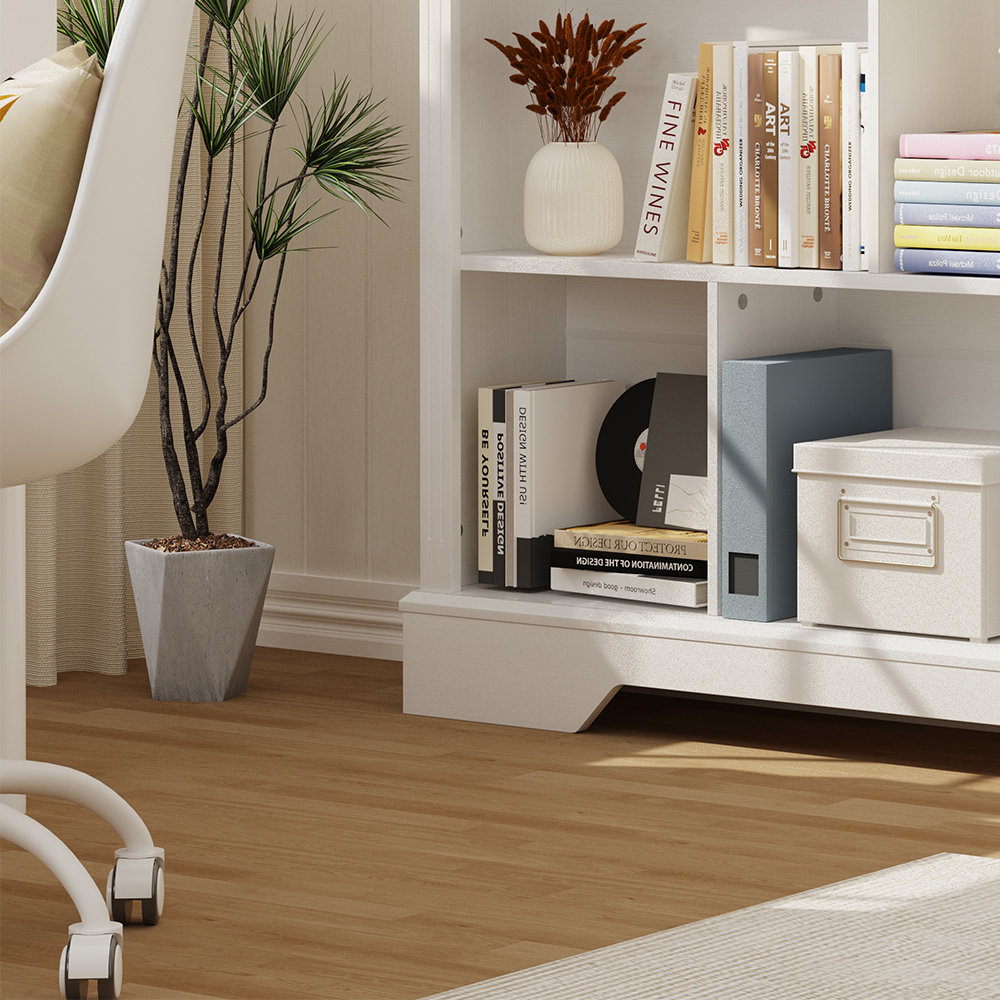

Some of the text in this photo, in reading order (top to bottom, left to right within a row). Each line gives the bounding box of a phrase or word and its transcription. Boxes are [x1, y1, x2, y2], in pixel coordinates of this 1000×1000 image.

[659, 100, 682, 151] FINE
[765, 101, 776, 136] ART
[780, 102, 790, 136] ART
[643, 161, 671, 237] WINES
